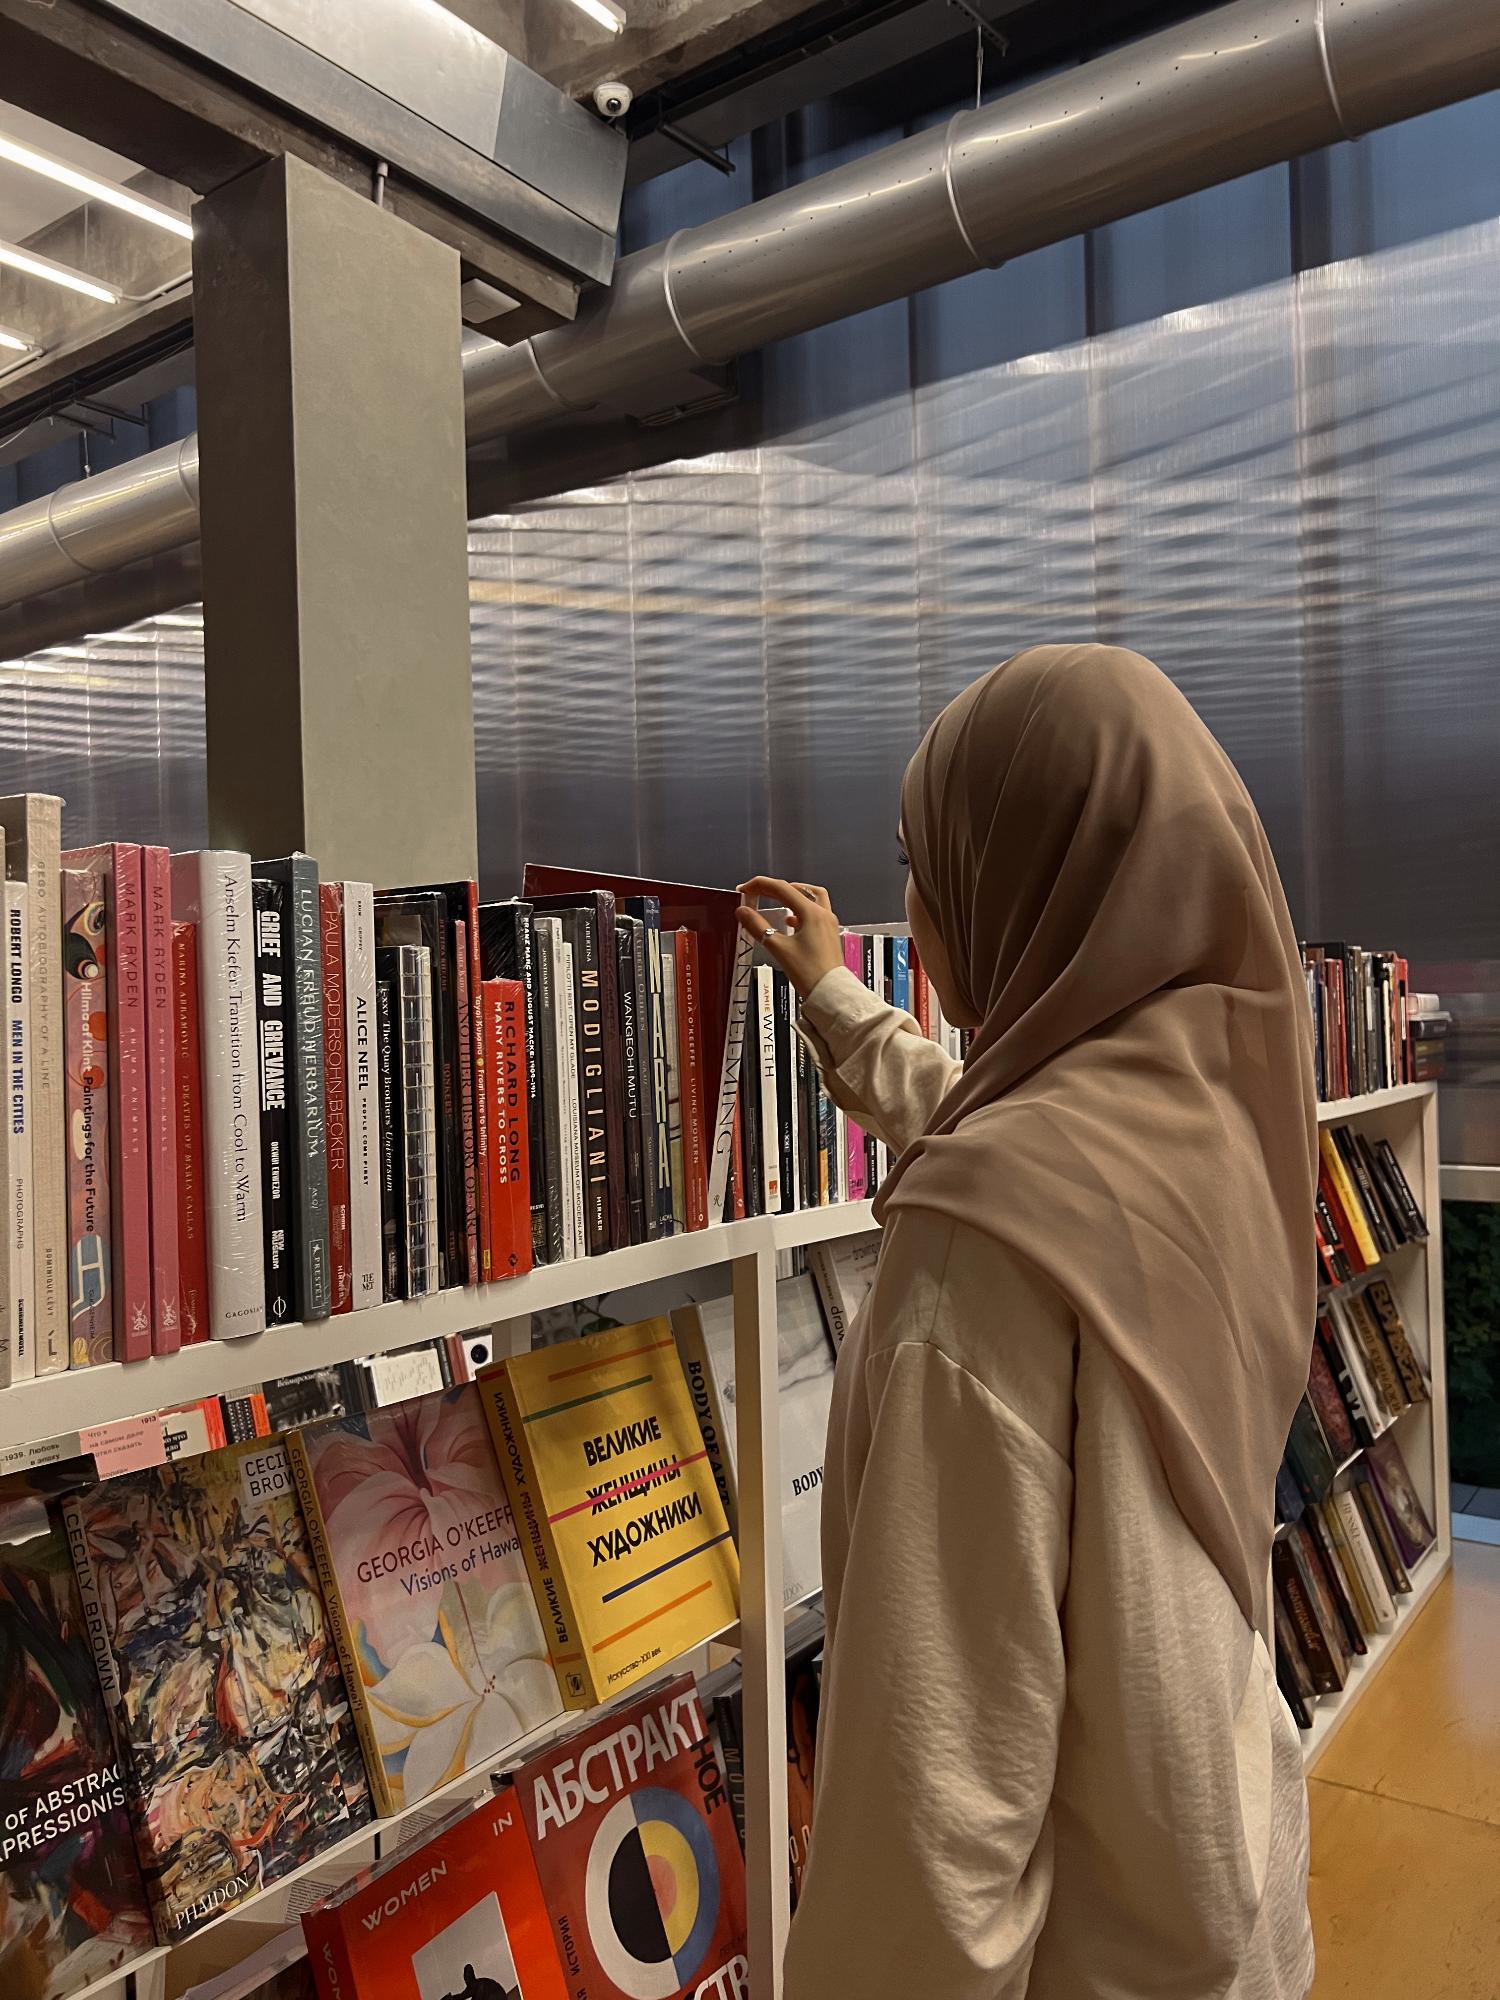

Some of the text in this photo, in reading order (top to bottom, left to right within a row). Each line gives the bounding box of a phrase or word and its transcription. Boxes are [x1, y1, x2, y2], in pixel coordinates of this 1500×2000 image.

[37, 860, 47, 899] GEGO
[224, 875, 240, 933] Anselm
[10, 909, 22, 1004] ROBERT LONGO
[126, 882, 139, 1009] MARK RYDEN
[153, 885, 167, 1009] MARK RYDEN
[523, 917, 531, 945] FRANZ
[524, 946, 532, 970] MARC
[585, 921, 593, 963] ALBERTINA
[38, 907, 49, 1020] AUTOBIOGRAPHY
[178, 942, 188, 987] MARINA
[457, 943, 466, 993] Anita Kunz
[525, 971, 533, 989] AND
[565, 953, 573, 992] PIPILOTTI
[685, 964, 695, 1013] GEORGIA
[734, 936, 754, 988] AN
[40, 1025, 50, 1043] OF
[229, 990, 244, 1069] Transition
[260, 910, 286, 1111] GRIEF AND GRIEVANCE
[301, 888, 321, 1157] LUCIAN FREUD HERBARIUM
[382, 1020, 392, 1045] The
[526, 991, 535, 1025] AUGUST
[567, 1014, 575, 1038] OPEN
[762, 983, 775, 1078] JAMIE WYETH
[325, 910, 346, 1170] PAULA MODERSOHN-BECKER
[356, 996, 369, 1091] ALICE NEEL
[381, 1044, 392, 1076] Quay
[459, 998, 472, 1088] ANOTHER
[568, 1038, 576, 1051] MY
[569, 1052, 577, 1079] GLADE
[623, 991, 638, 1119] WANGECHI MUTU
[688, 1017, 697, 1067] O'KEEFFE
[11, 1019, 25, 1135] MEN IN THE CITIES
[41, 1060, 51, 1090] LINE
[231, 1074, 246, 1110] from
[473, 994, 488, 1157] Yayoi Kusama From Here to Infinity
[494, 1001, 508, 1184] MANY RIVERS TO CROSS
[505, 1001, 521, 1183] RICHARD LONG
[582, 969, 607, 1183] MODIGLIANI
[80, 981, 96, 1233] Hilma af Klint Paintings for the Future
[233, 1114, 249, 1152] Cool
[462, 1092, 475, 1170] HISTORY
[571, 1097, 579, 1141] LOUISIANA
[690, 1077, 700, 1164] LIVING MODERN
[185, 1153, 194, 1190] MARIA
[235, 1157, 247, 1173] to
[271, 1141, 280, 1166] OKWUI
[384, 1131, 395, 1193] Universum
[573, 1142, 581, 1178] MUSEUM
[16, 1178, 25, 1250] PHOTOGRAPHS
[236, 1175, 251, 1222] Warm
[575, 1179, 582, 1191] OF
[575, 1192, 583, 1229] MODERN
[595, 1196, 604, 1232] HIRMER
[186, 1194, 195, 1240] CALLAS
[271, 1230, 281, 1270] MUSEUM
[313, 1256, 324, 1302] PRESTEL
[141, 1415, 157, 1425] 1913
[583, 1416, 662, 1467] ВЕЛИКИЕ
[688, 1360, 730, 1506] BODY OF ART
[245, 1451, 292, 1477] CECIL
[250, 1468, 296, 1497] BROW
[585, 1454, 681, 1516] ЖЕНЩИНЫ
[357, 1504, 514, 1583] GEORGIA O'KEEFF
[492, 1391, 569, 1644] ВЕЛИКИЕ ЖЕНЩИНЫ ХУДОЖНИКИ
[587, 1491, 703, 1568] ХУДОЖНИКИ
[292, 1448, 314, 1519] GEORGIA
[309, 1520, 333, 1592] O'KEEFFE
[328, 1596, 345, 1643] Visions
[340, 1645, 351, 1663] of
[400, 1537, 520, 1596] Visions of Hawa
[66, 1513, 115, 1692] CECILY BROWN
[535, 1687, 707, 1841] АБСТРАКТ
[687, 1741, 729, 1816] НОЕ
[0, 1786, 125, 1862] PRESSIONIS
[5, 1763, 120, 1830] OF ABSTRAC
[361, 1860, 448, 1931] WOMEN
[491, 1813, 513, 1838] IN
[175, 1872, 251, 1931] PHAIDON
[558, 1915, 581, 1977] ИСТОРИЯ
